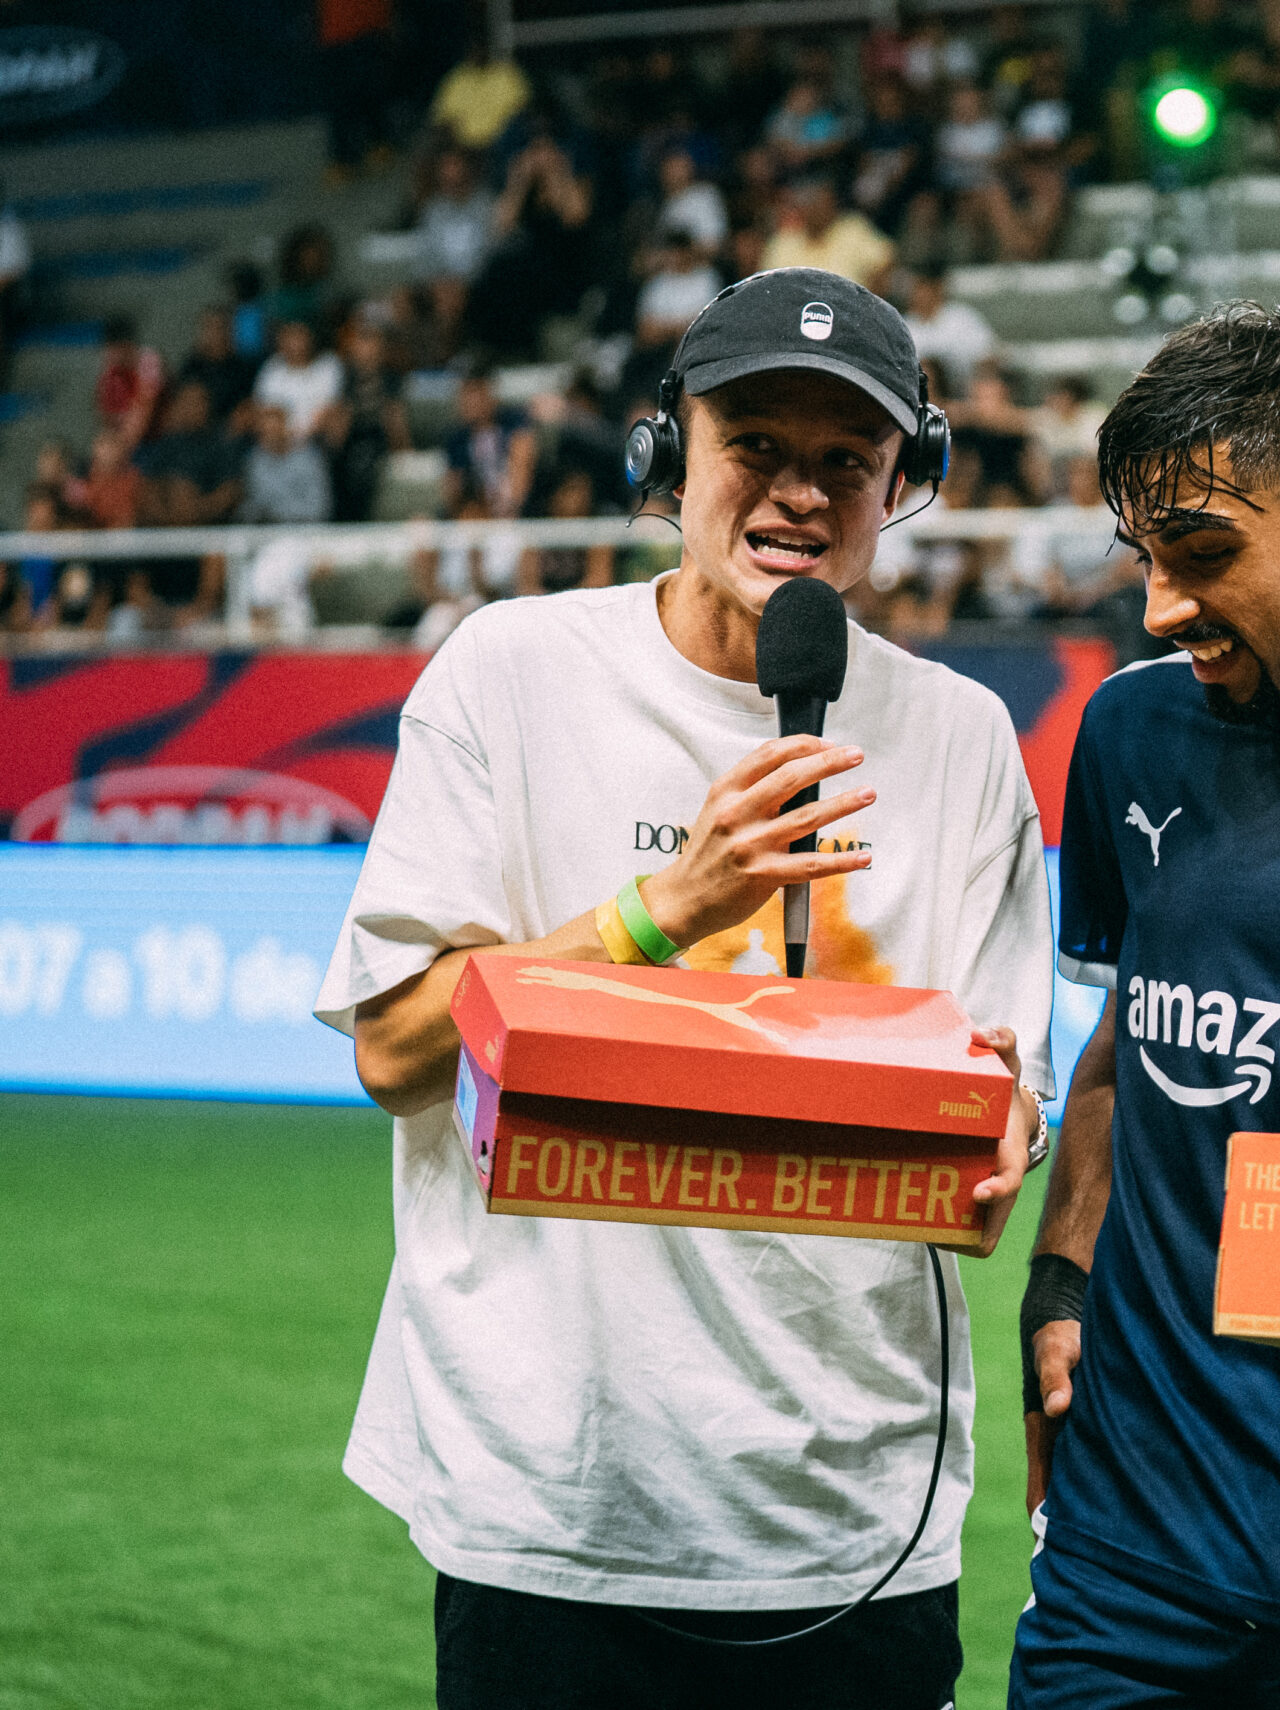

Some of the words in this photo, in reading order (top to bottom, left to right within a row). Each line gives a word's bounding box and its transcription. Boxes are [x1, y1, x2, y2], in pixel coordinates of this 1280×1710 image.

[804, 311, 831, 322] PUMA
[631, 821, 690, 855] DON
[939, 1101, 982, 1119] PUMA
[505, 1134, 757, 1210] FOREVER.
[773, 1153, 973, 1226] BETTER.
